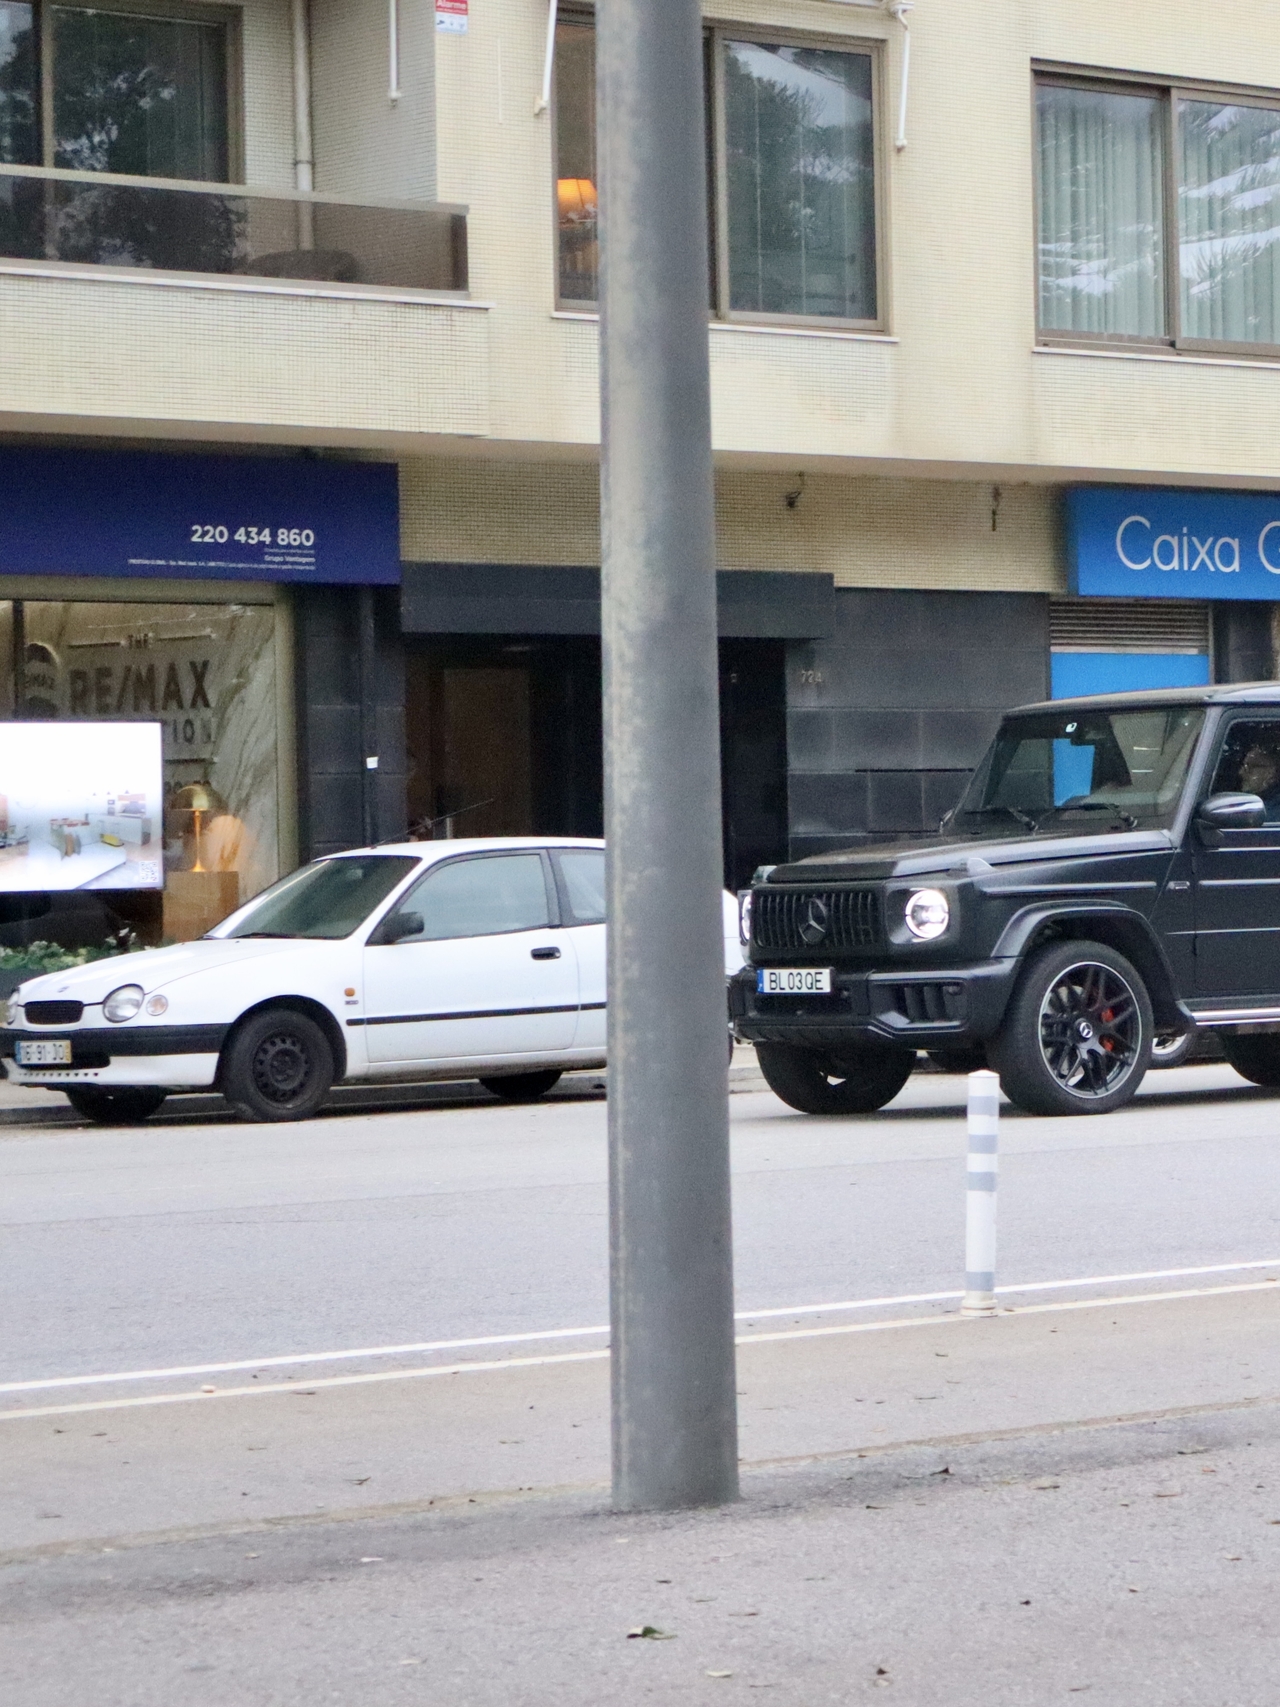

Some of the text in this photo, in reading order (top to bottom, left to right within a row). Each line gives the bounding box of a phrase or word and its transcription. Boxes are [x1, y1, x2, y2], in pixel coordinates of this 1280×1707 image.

[190, 524, 315, 547] 220 434 860
[1116, 515, 1240, 573] Caixa
[69, 659, 211, 716] RE/MAX
